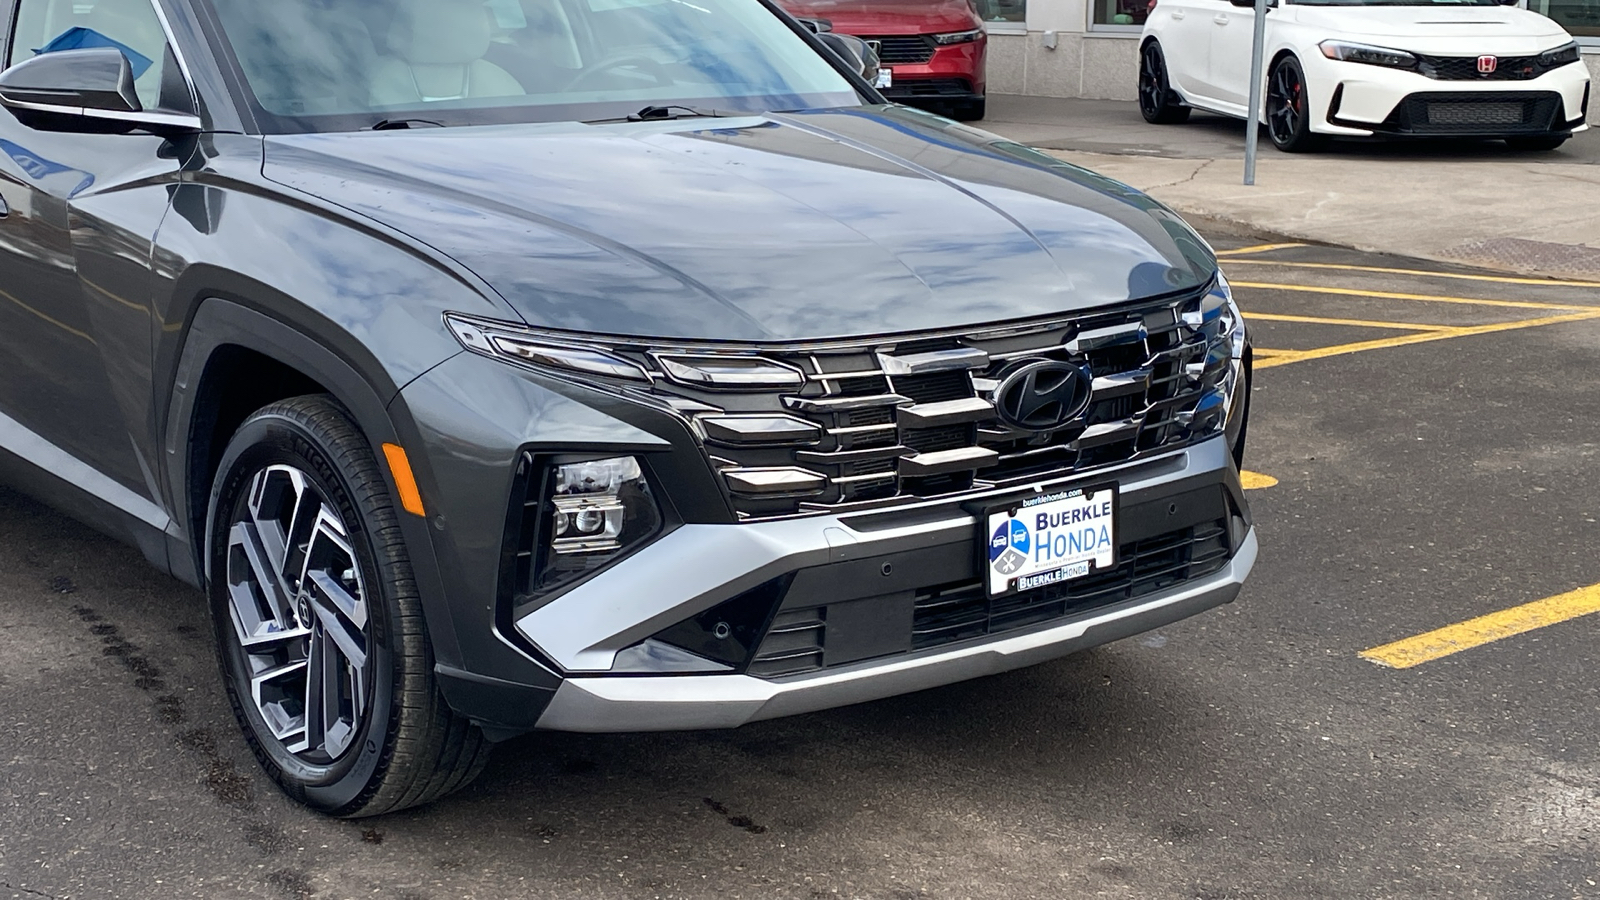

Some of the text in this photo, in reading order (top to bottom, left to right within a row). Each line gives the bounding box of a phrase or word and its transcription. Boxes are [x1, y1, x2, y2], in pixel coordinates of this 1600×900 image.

[295, 437, 361, 533] MICHELIN
[1022, 489, 1083, 507] buerklehonda.com
[1035, 501, 1111, 531] BUERKLE
[1035, 524, 1111, 562] HONDA
